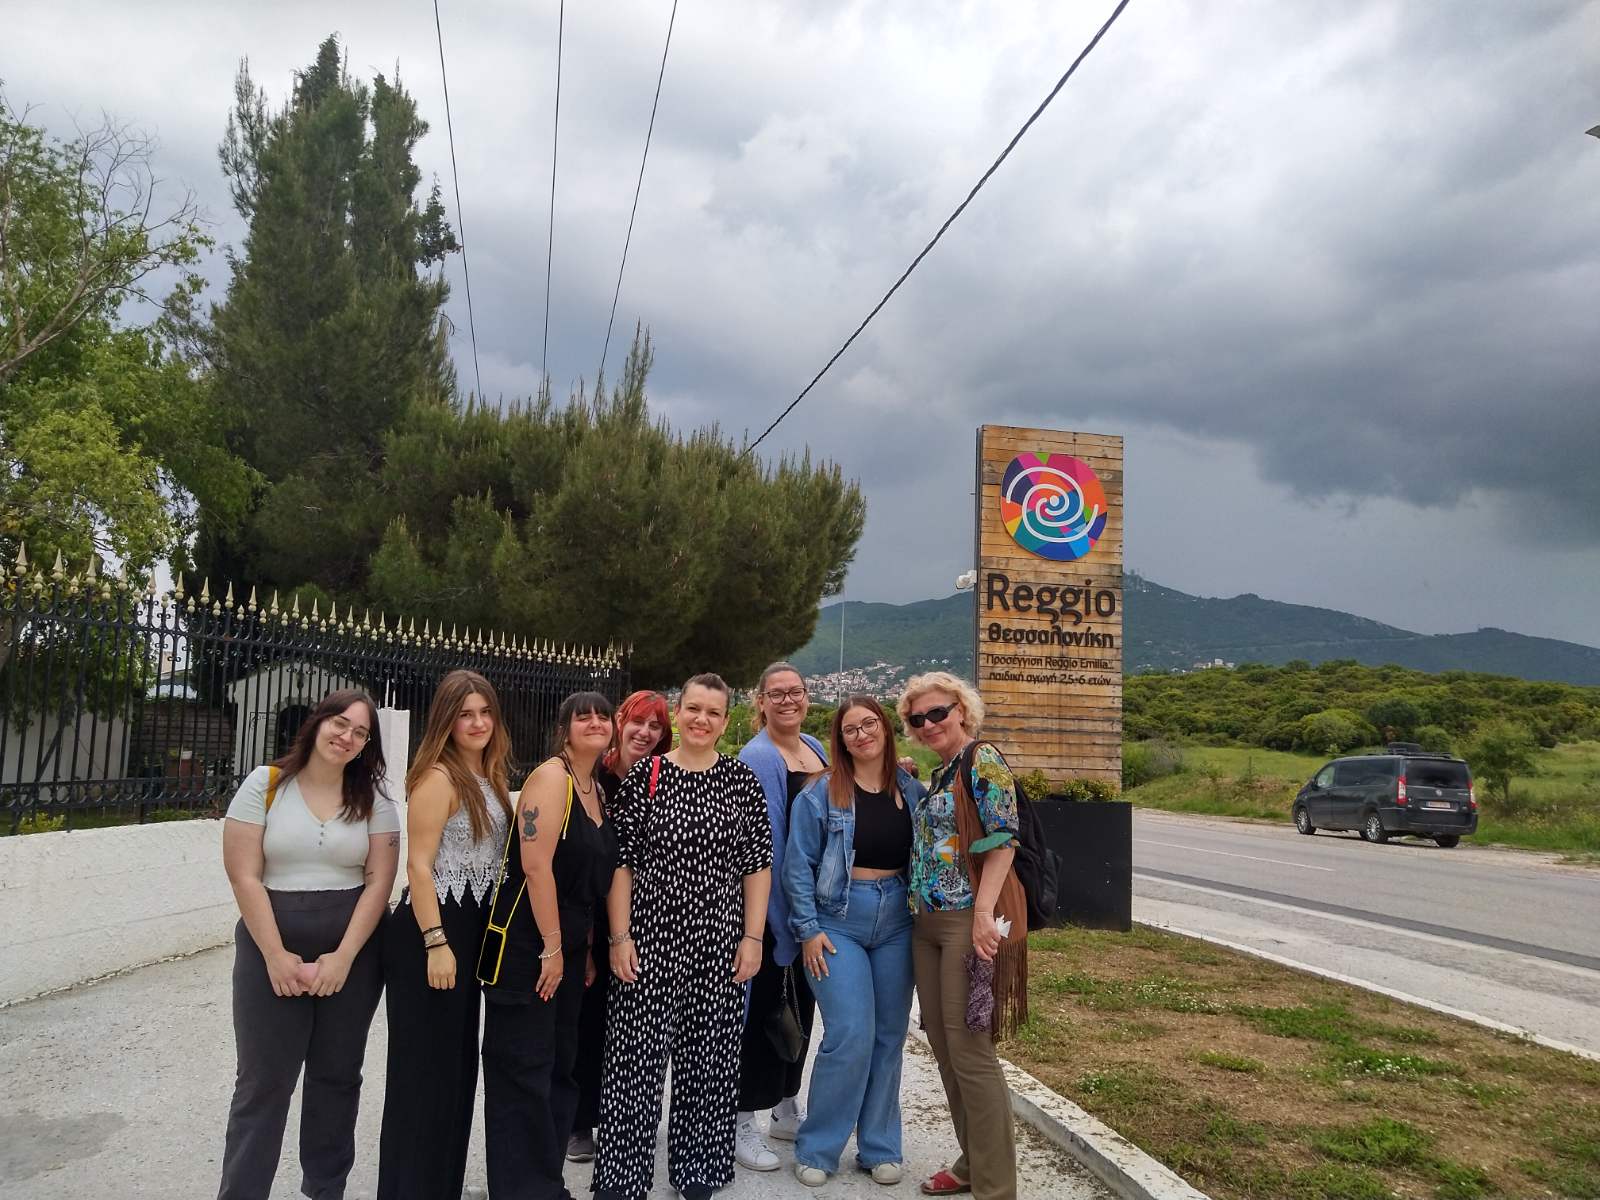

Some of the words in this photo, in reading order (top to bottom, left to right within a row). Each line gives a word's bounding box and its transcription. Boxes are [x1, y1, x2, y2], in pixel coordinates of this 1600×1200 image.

[987, 573, 1115, 625] Reggio
[986, 655, 1042, 667] Προσέγγιση
[1045, 656, 1077, 670] Reggio
[989, 671, 1024, 681] παιδική
[1026, 673, 1056, 685] αγωγή
[1088, 675, 1112, 686] ετών
